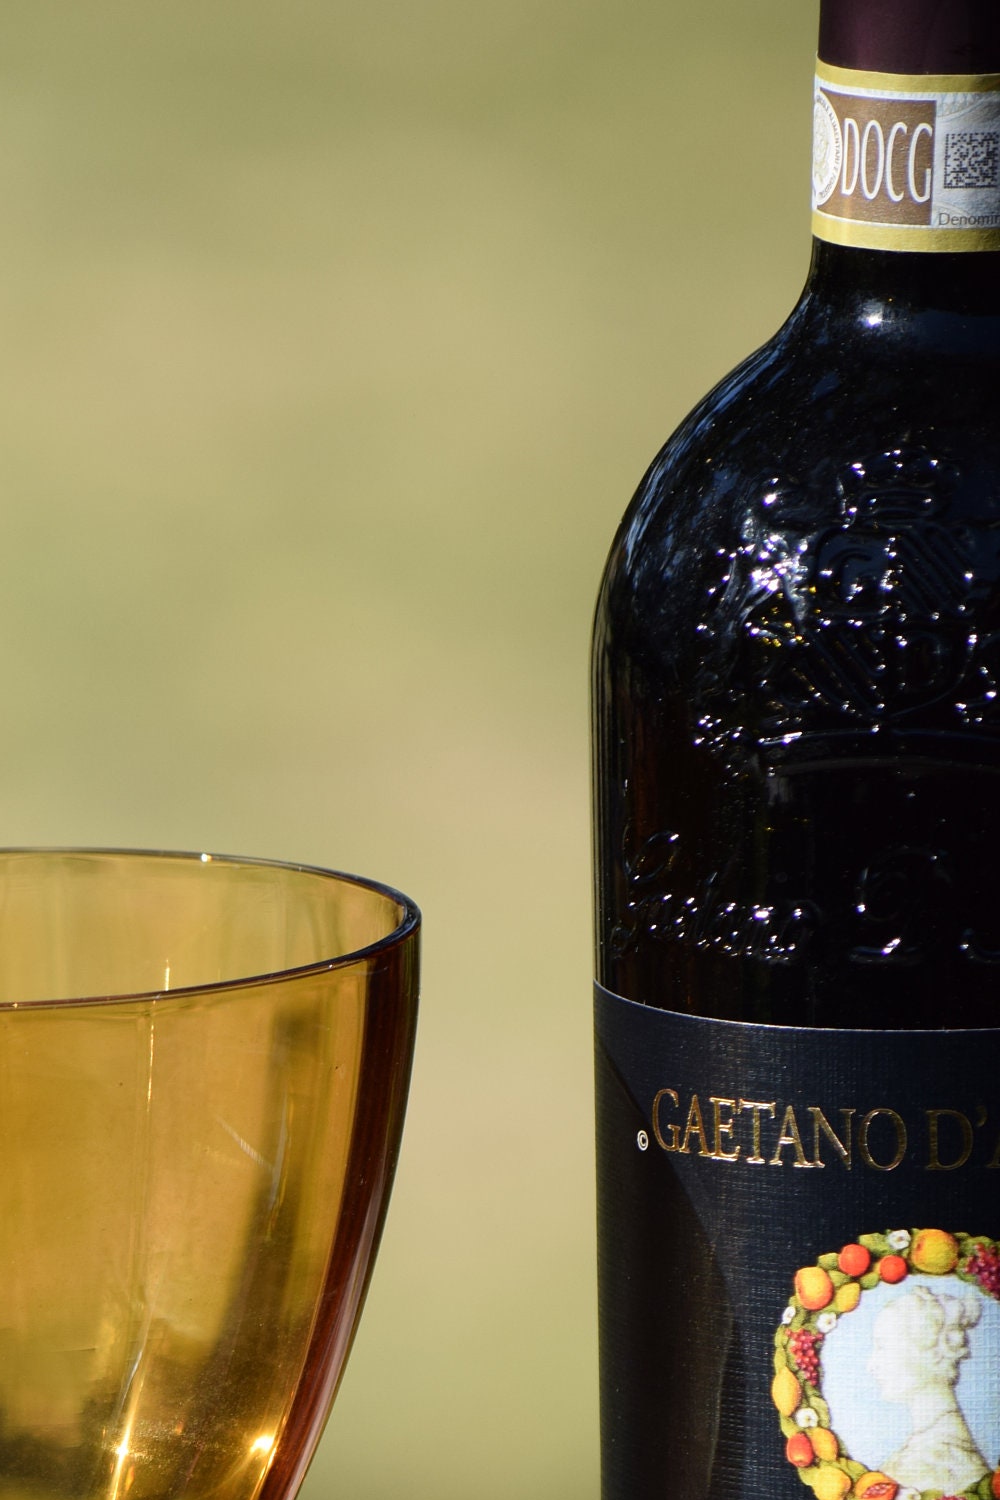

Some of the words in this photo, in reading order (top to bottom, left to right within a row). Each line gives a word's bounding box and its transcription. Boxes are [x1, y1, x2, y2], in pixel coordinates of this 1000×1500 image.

[841, 117, 933, 203] DOCG
[652, 1088, 908, 1171] GAETANO
[924, 1105, 1000, 1171] D'
